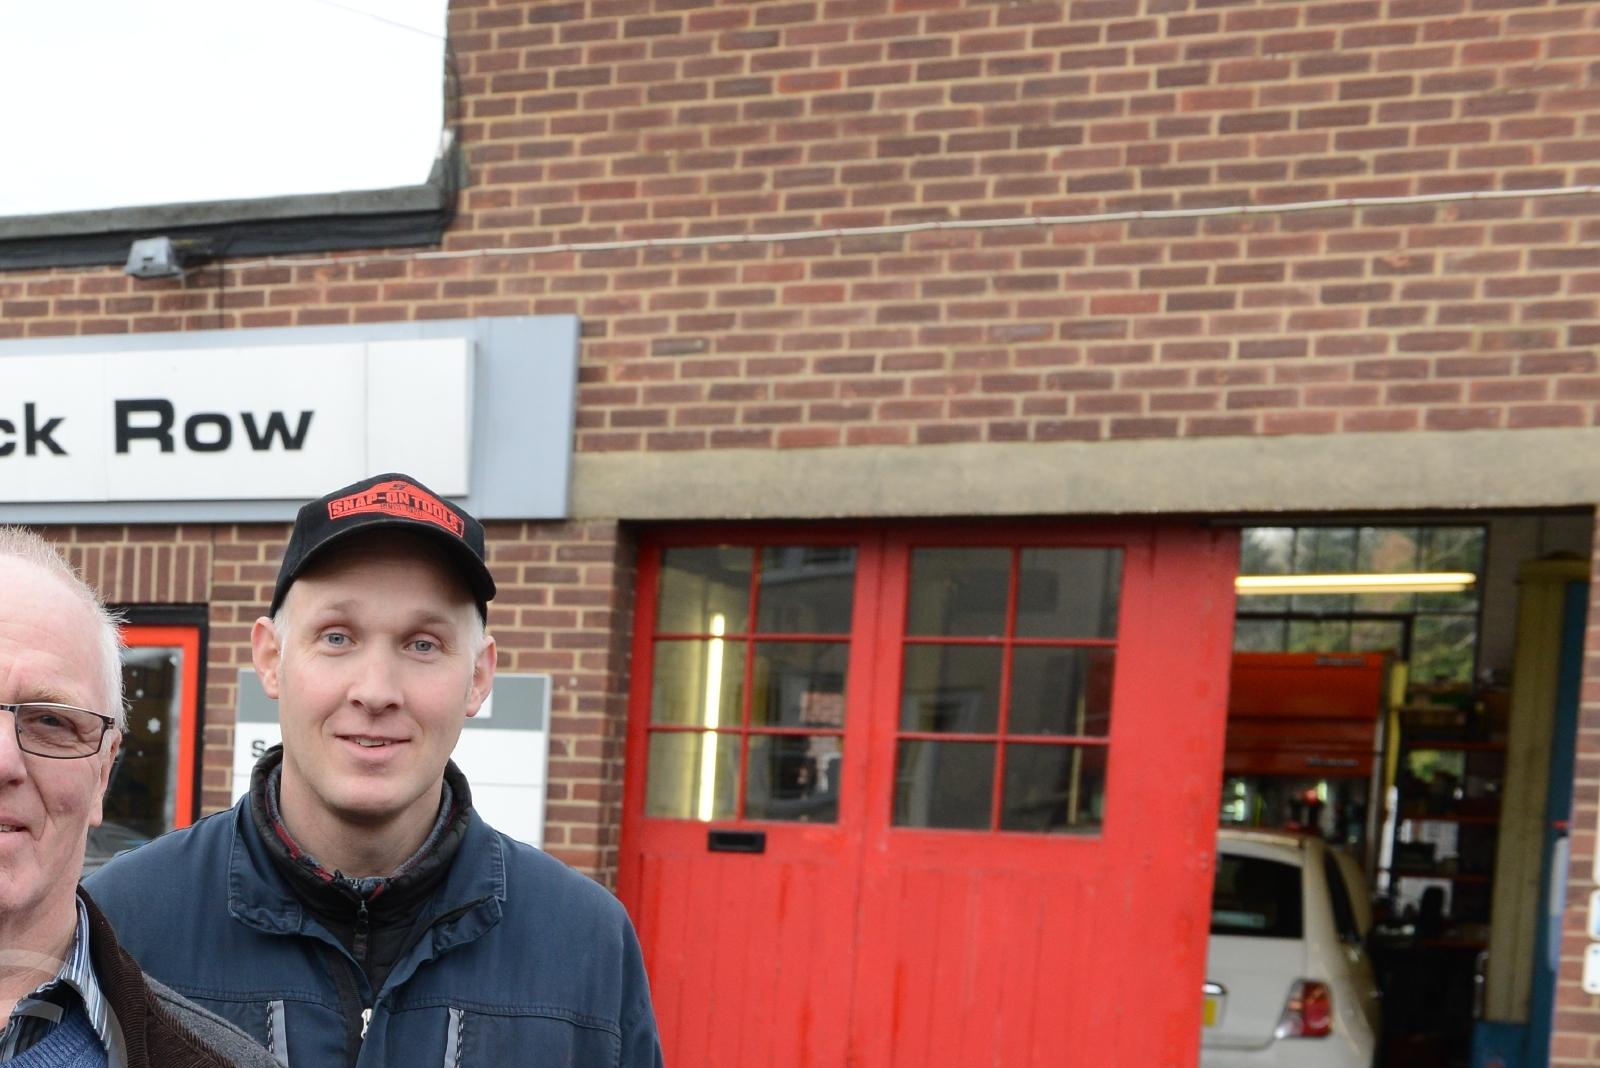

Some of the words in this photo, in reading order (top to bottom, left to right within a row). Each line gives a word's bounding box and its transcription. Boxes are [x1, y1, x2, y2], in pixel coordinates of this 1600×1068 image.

[113, 397, 315, 455] Row
[330, 491, 410, 514] SNAP-ON
[410, 495, 460, 532] TOOLS
